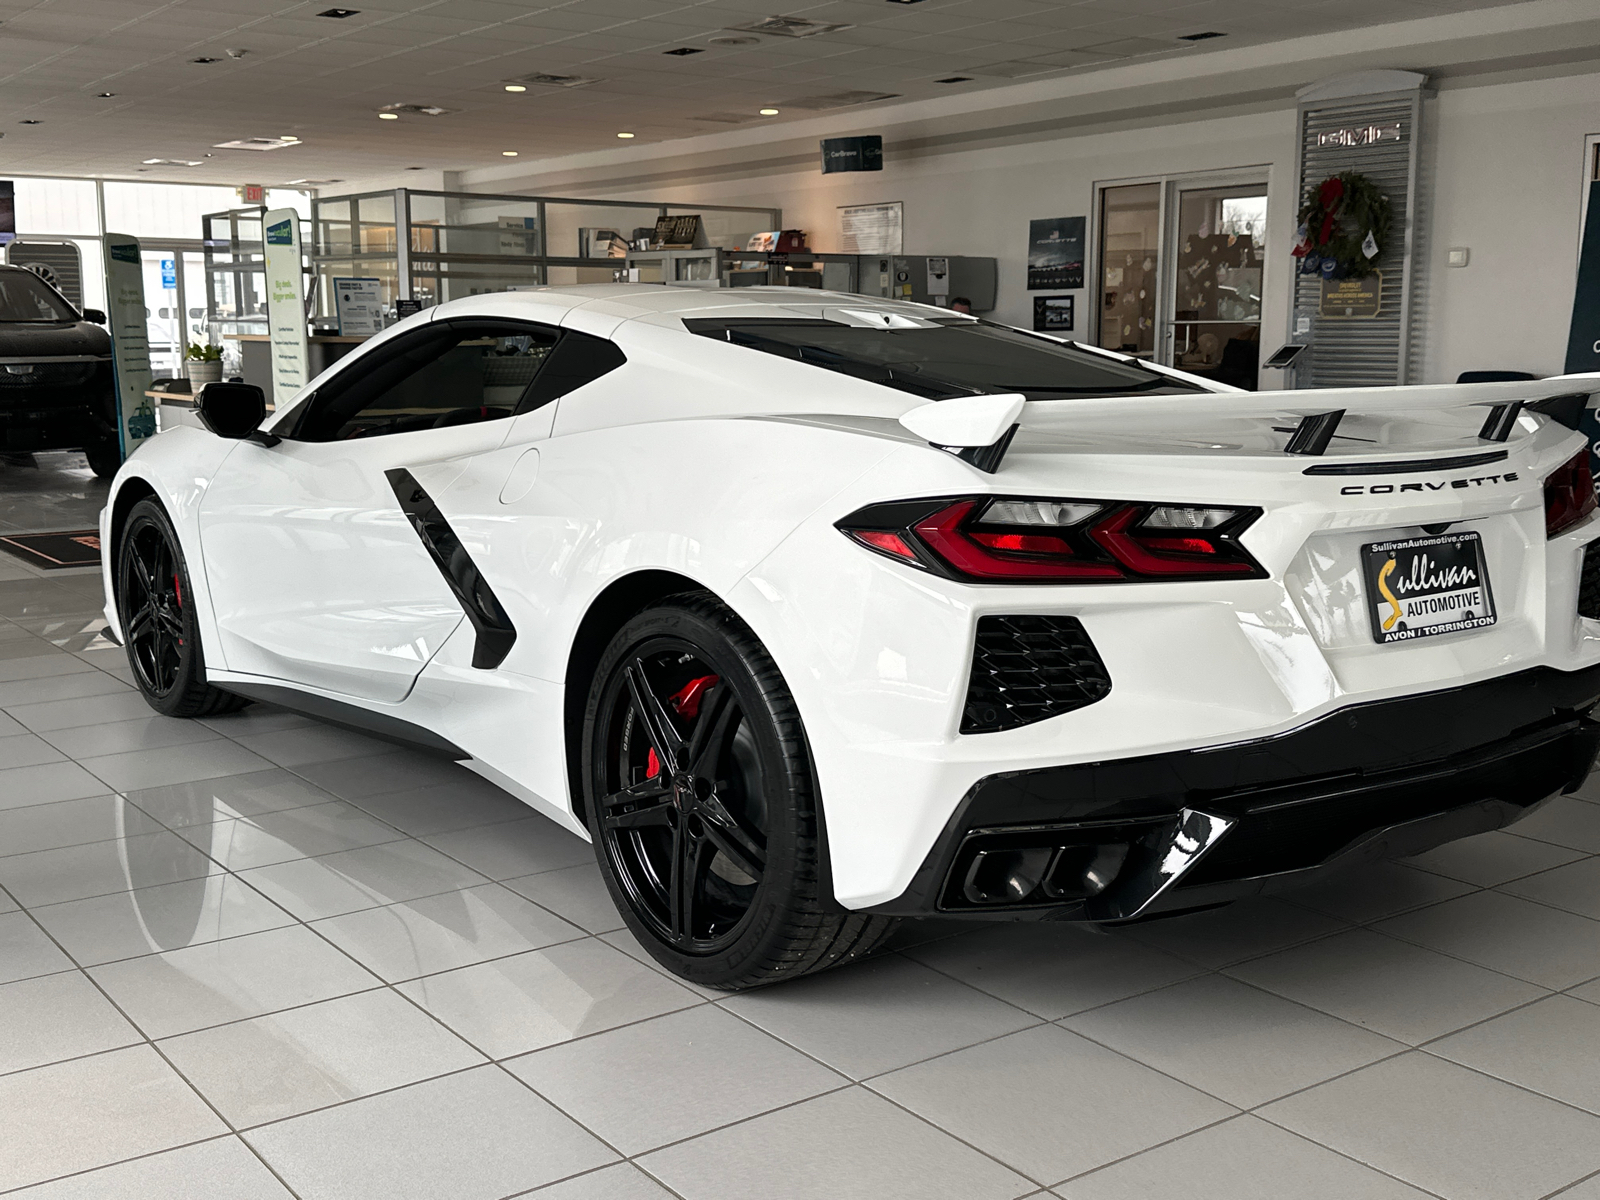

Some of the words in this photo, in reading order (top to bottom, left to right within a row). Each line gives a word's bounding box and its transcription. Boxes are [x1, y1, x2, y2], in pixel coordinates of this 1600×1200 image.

[830, 150, 857, 158] CarBravo
[247, 187, 262, 200] EXIT
[1340, 472, 1519, 495] CORVETTE
[1371, 533, 1478, 553] SullivanAutomotive.com
[1378, 554, 1476, 631] Sullivan
[1407, 591, 1480, 618] AUTOMOTIVE
[1384, 629, 1416, 642] AVON
[1423, 616, 1495, 635] TORRINGTON
[623, 706, 634, 751] FORGED
